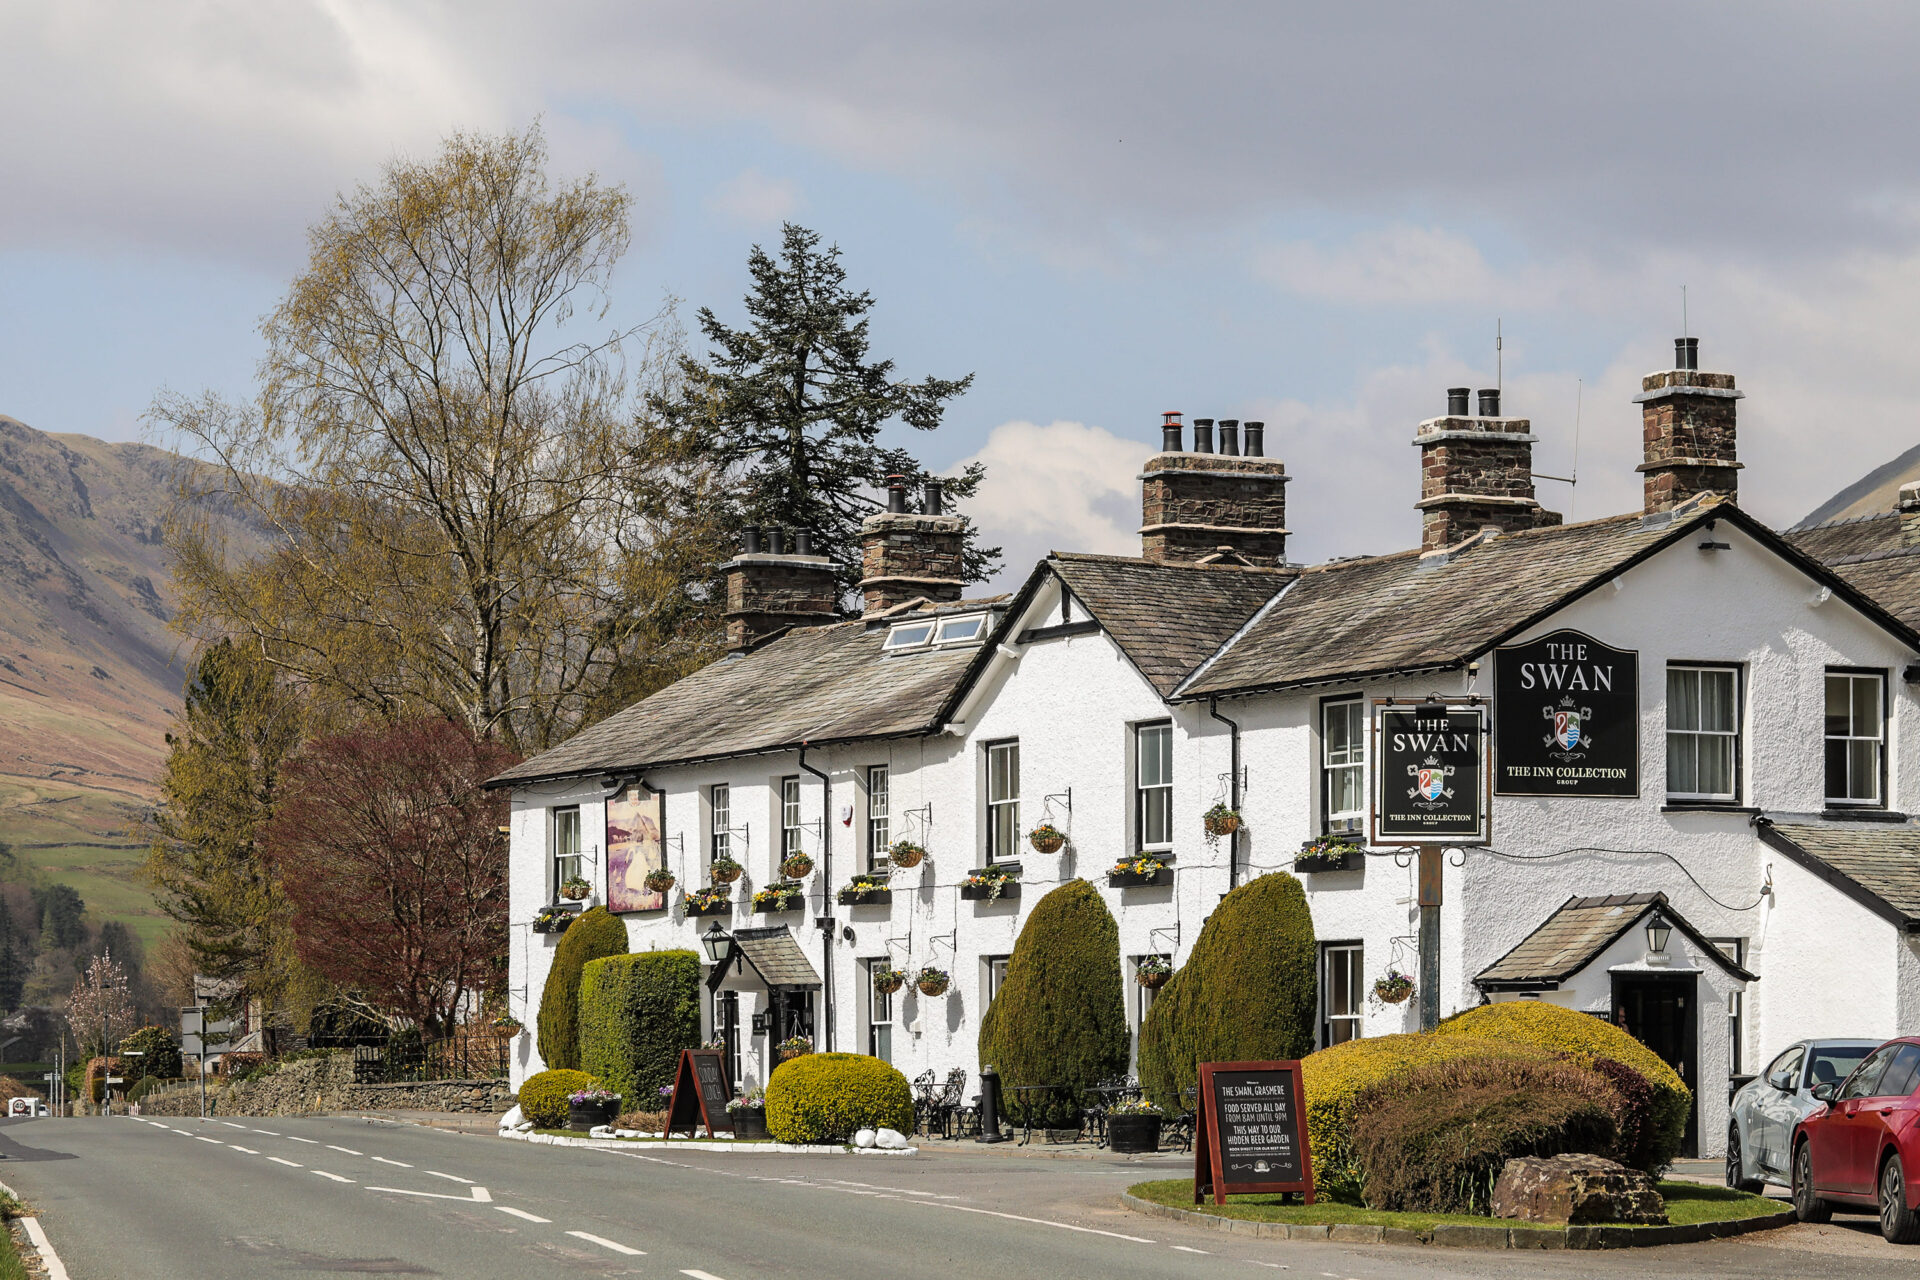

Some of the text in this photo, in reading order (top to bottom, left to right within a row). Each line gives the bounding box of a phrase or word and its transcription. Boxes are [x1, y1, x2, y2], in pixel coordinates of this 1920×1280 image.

[1546, 643, 1587, 661] THE
[1521, 663, 1613, 692] SWAN
[1414, 719, 1449, 732] THE
[1393, 734, 1469, 752] SWAN
[1507, 766, 1627, 779] THE INN COLLECTION
[699, 1067, 719, 1083] SUNDAY
[703, 1084, 723, 1100] LUNCH
[1222, 1085, 1284, 1096] THE SWAN, GRASMERE
[1224, 1102, 1286, 1112] FOOD SERVED ALL DAY
[1225, 1113, 1287, 1122] FROM 8AM UNTIL 9PM
[1233, 1125, 1281, 1134] THIS WAY TO OUR
[1228, 1135, 1289, 1145] HIDDEN BEER GARDEN
